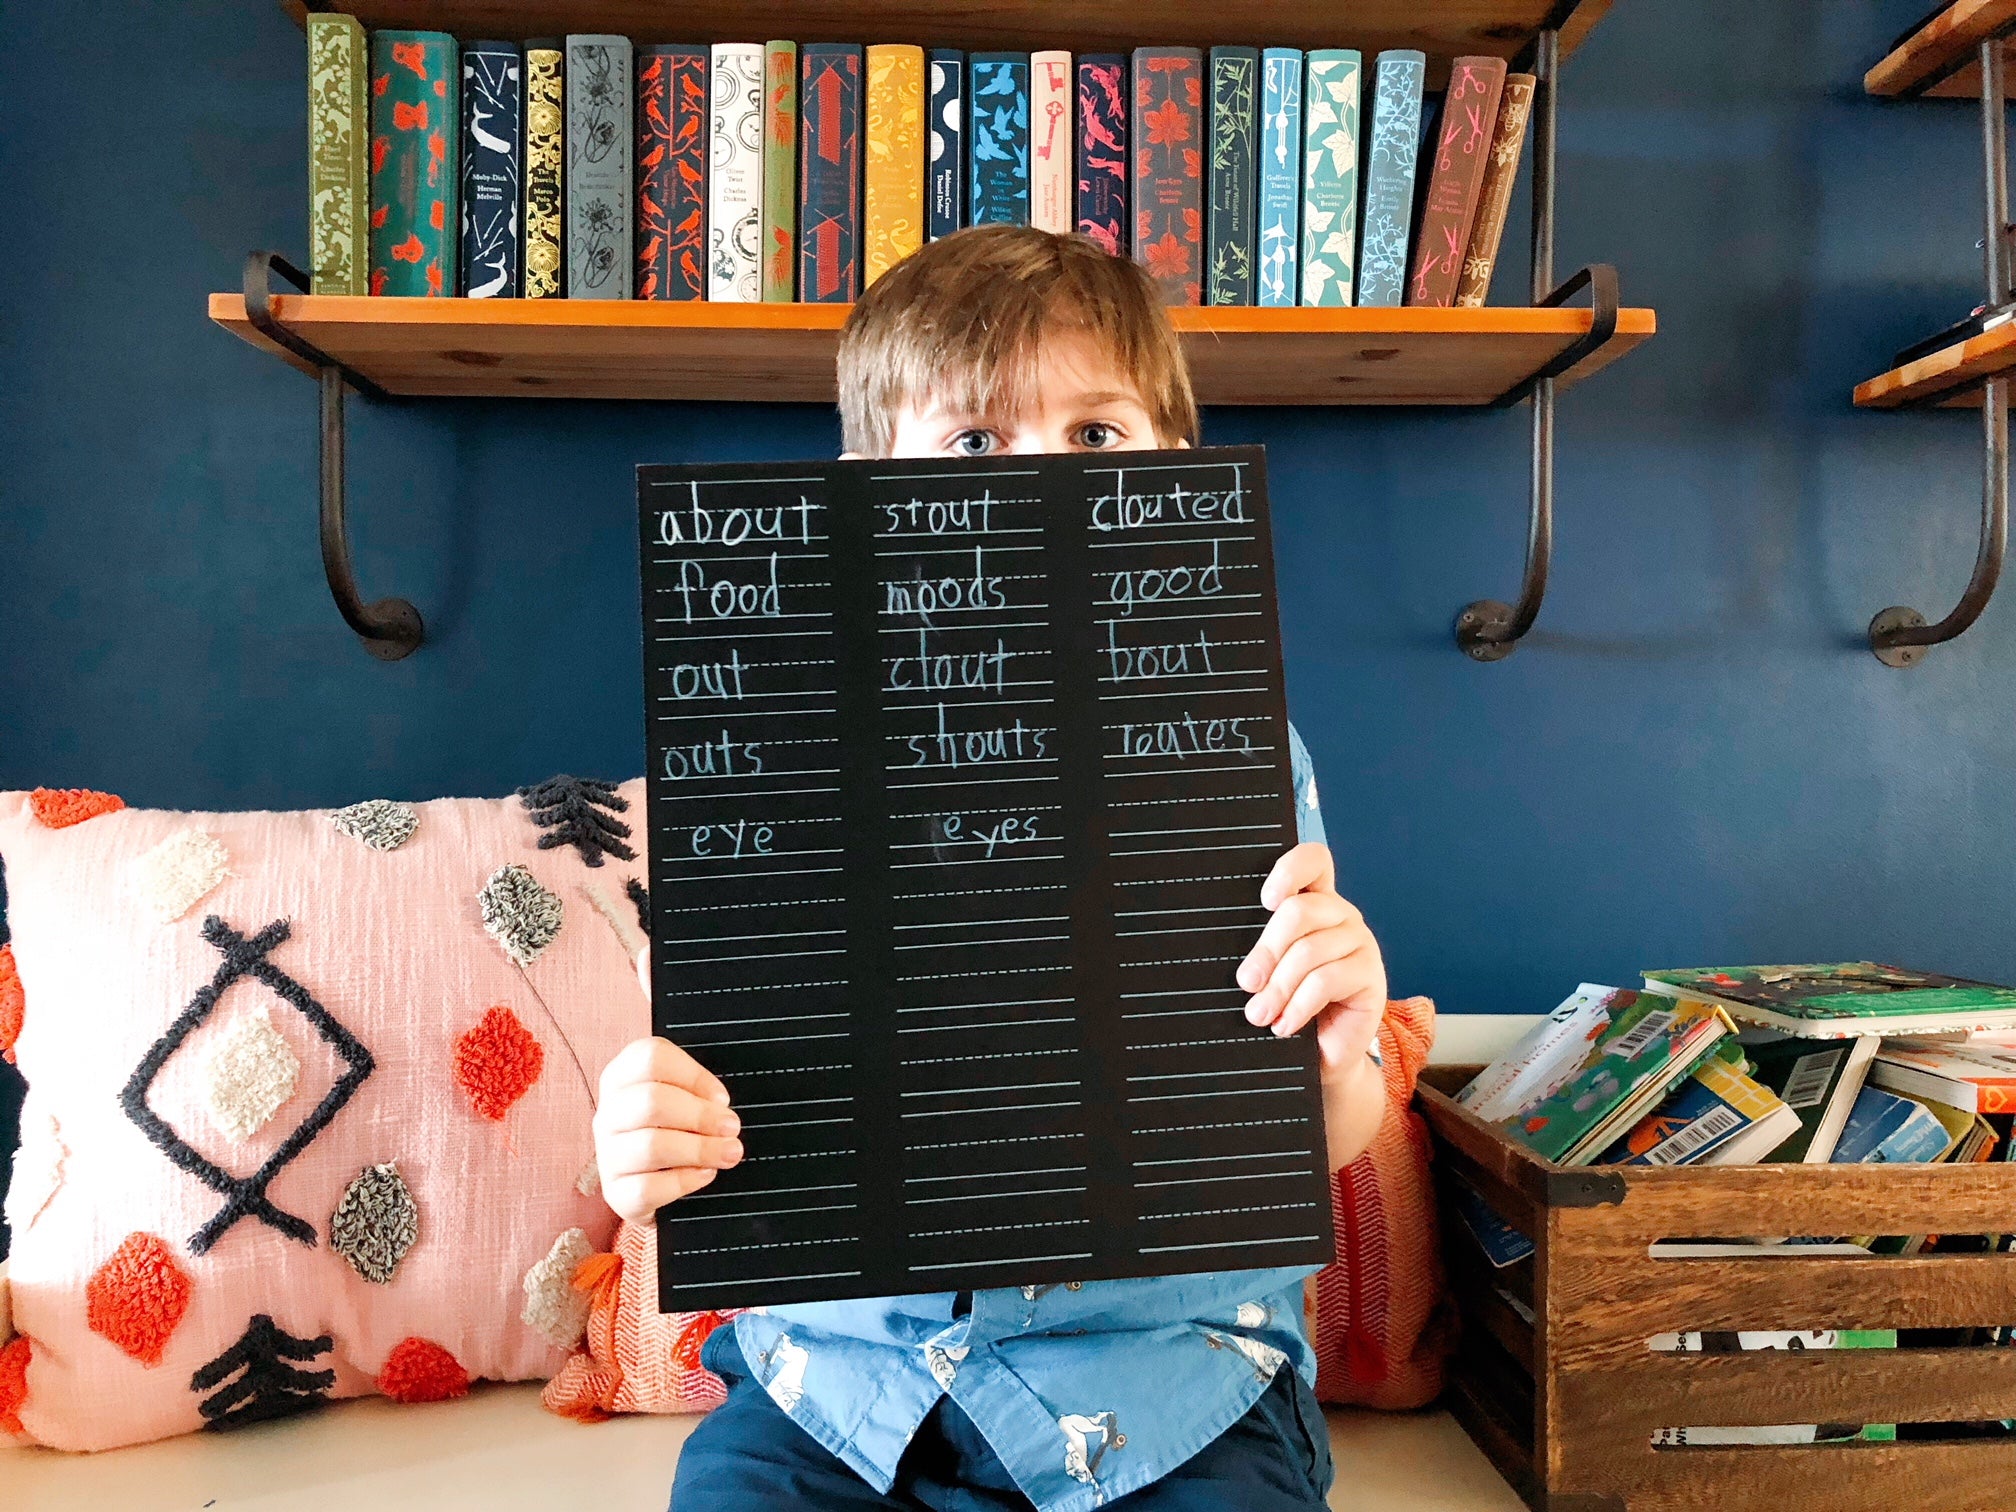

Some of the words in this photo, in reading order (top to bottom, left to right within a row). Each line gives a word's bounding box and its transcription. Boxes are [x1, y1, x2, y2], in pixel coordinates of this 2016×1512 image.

[472, 173, 507, 182] Moby-Dick
[476, 193, 503, 201] Melville
[477, 185, 503, 193] Herman
[661, 481, 819, 545] about
[888, 489, 998, 535] stout
[1092, 464, 1244, 532] clouted
[674, 552, 782, 624] food
[886, 545, 1006, 615] moods
[1110, 538, 1222, 617] good
[672, 649, 748, 700] out
[889, 628, 1016, 695] clout
[1109, 619, 1214, 684] bout
[664, 729, 763, 779] outs
[908, 702, 1046, 769] shouts
[692, 818, 773, 859] eye
[944, 812, 1038, 858] eyes
